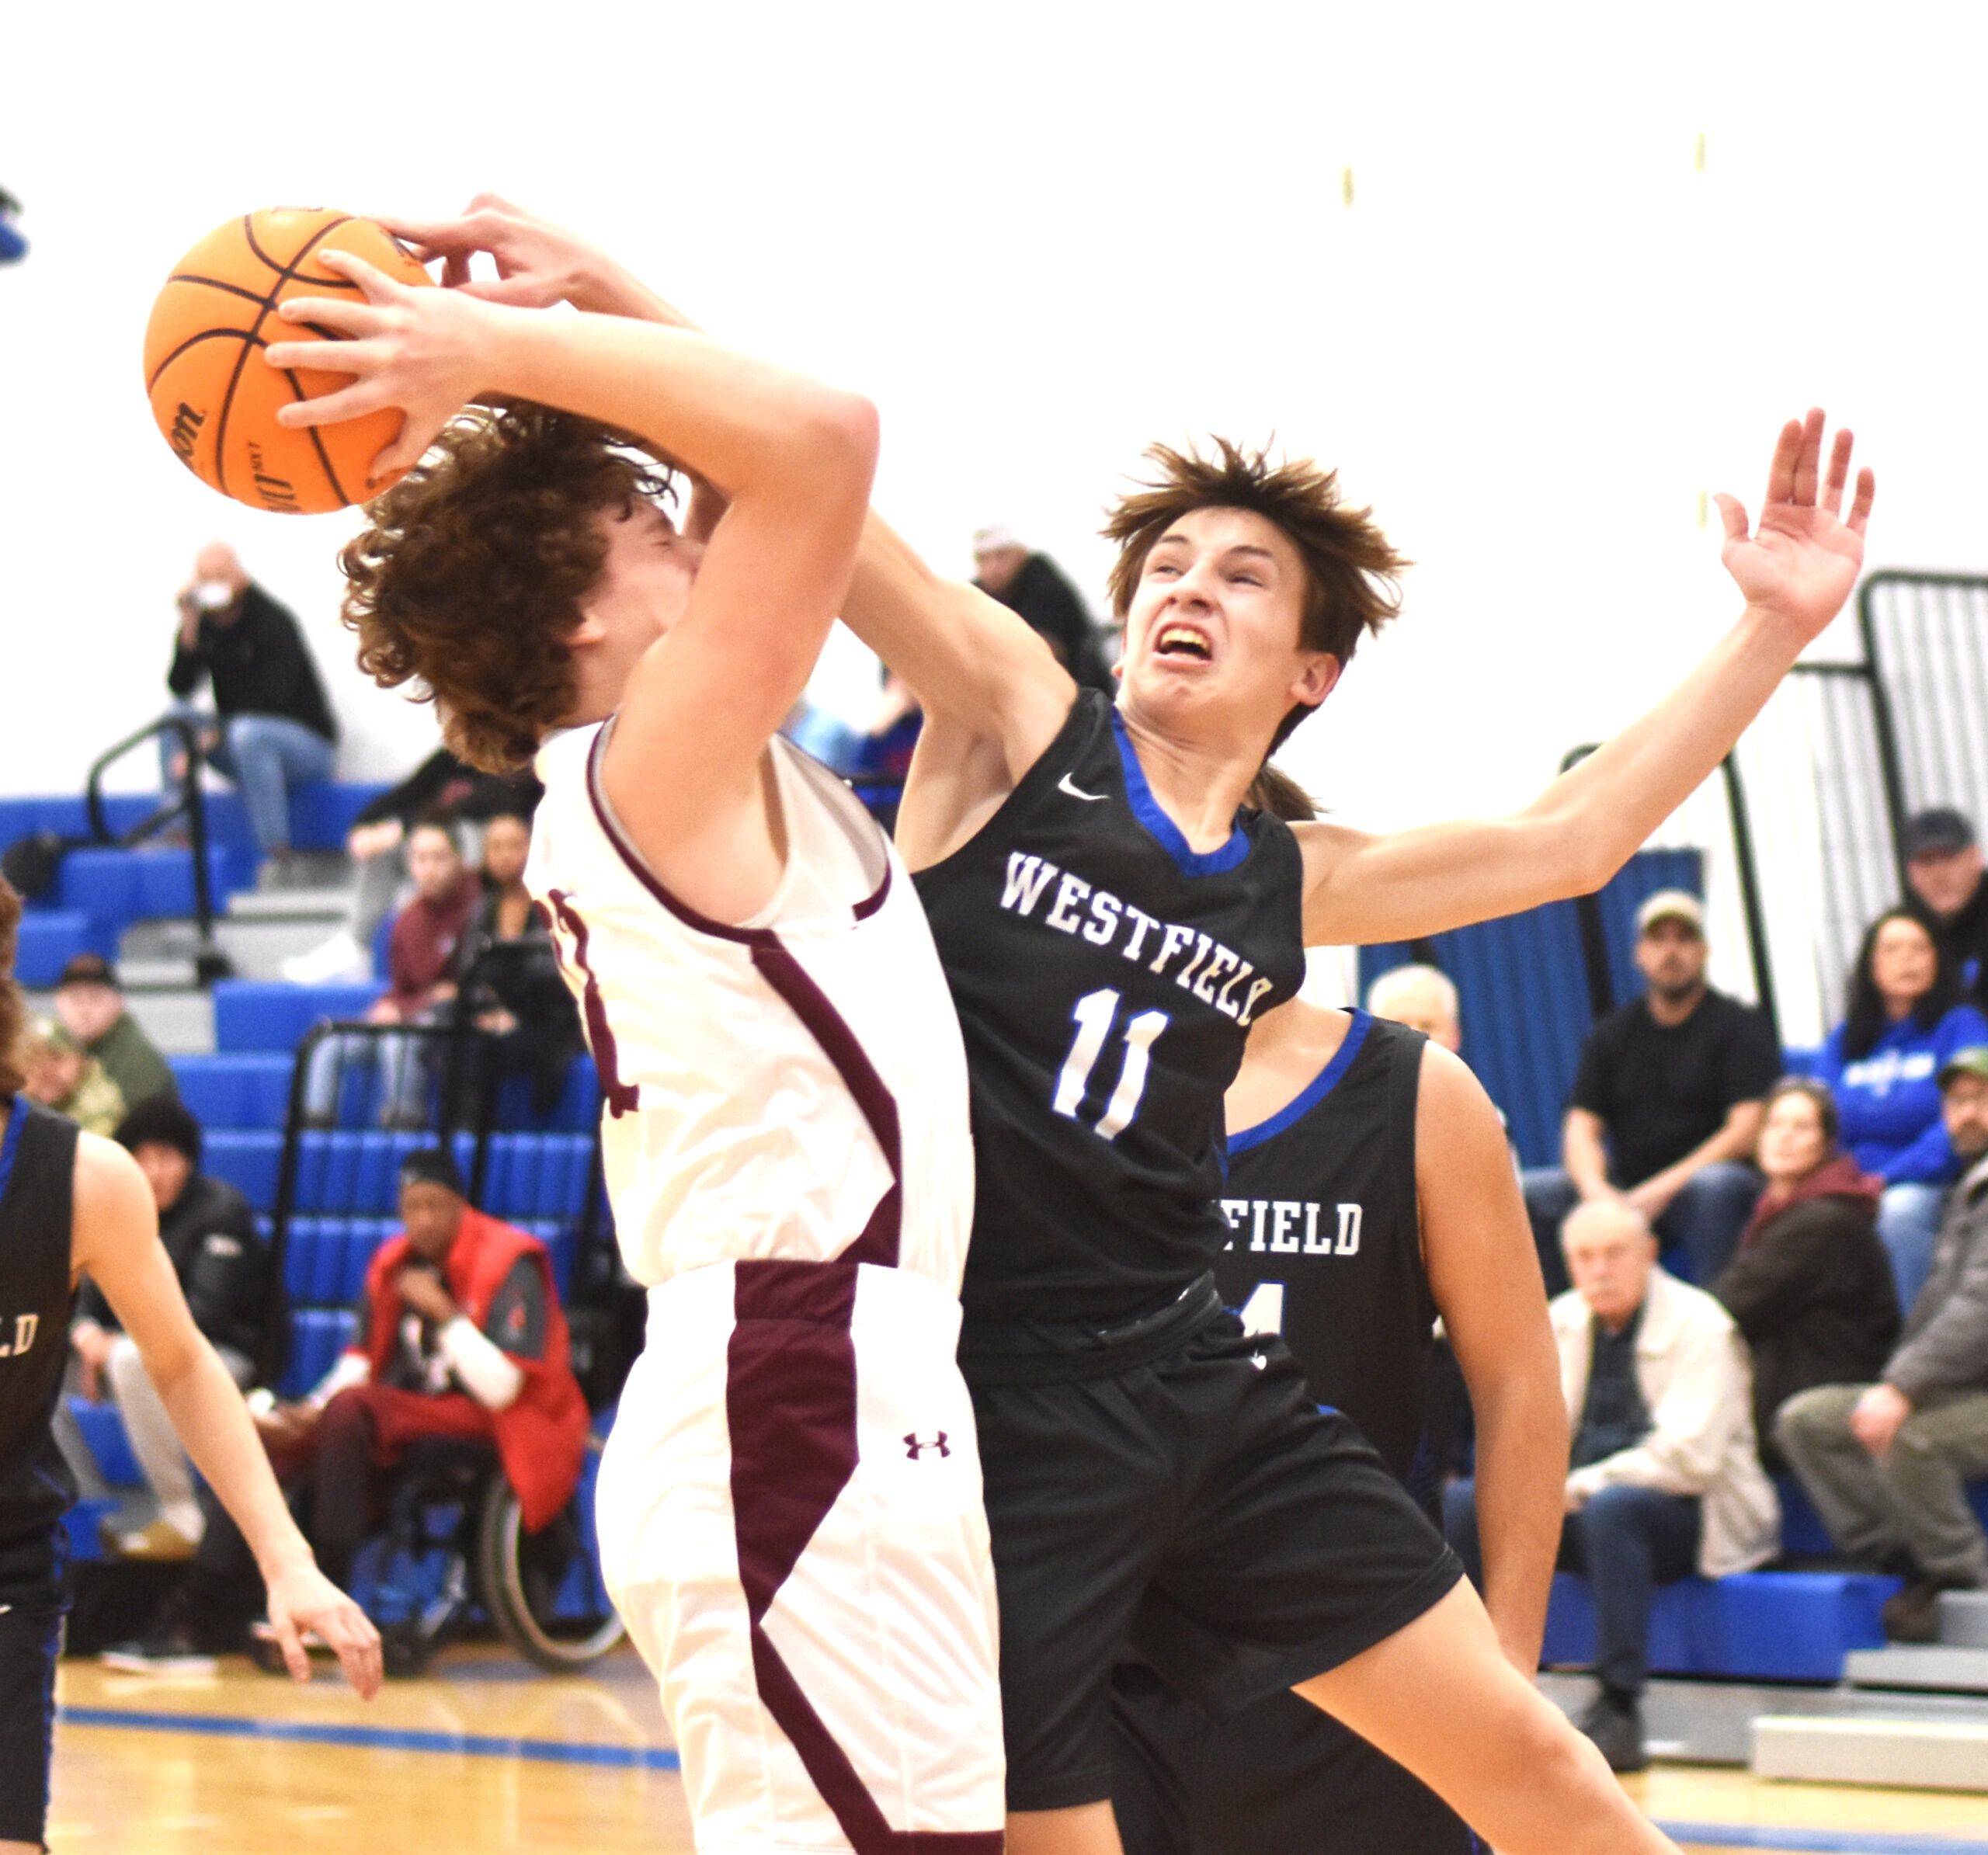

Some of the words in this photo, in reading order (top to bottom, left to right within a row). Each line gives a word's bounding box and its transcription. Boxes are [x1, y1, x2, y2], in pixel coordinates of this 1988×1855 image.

[1000, 851, 1273, 1027] WESTFIELD
[1051, 985, 1171, 1145] 11
[1219, 1199, 1364, 1256] FIELD
